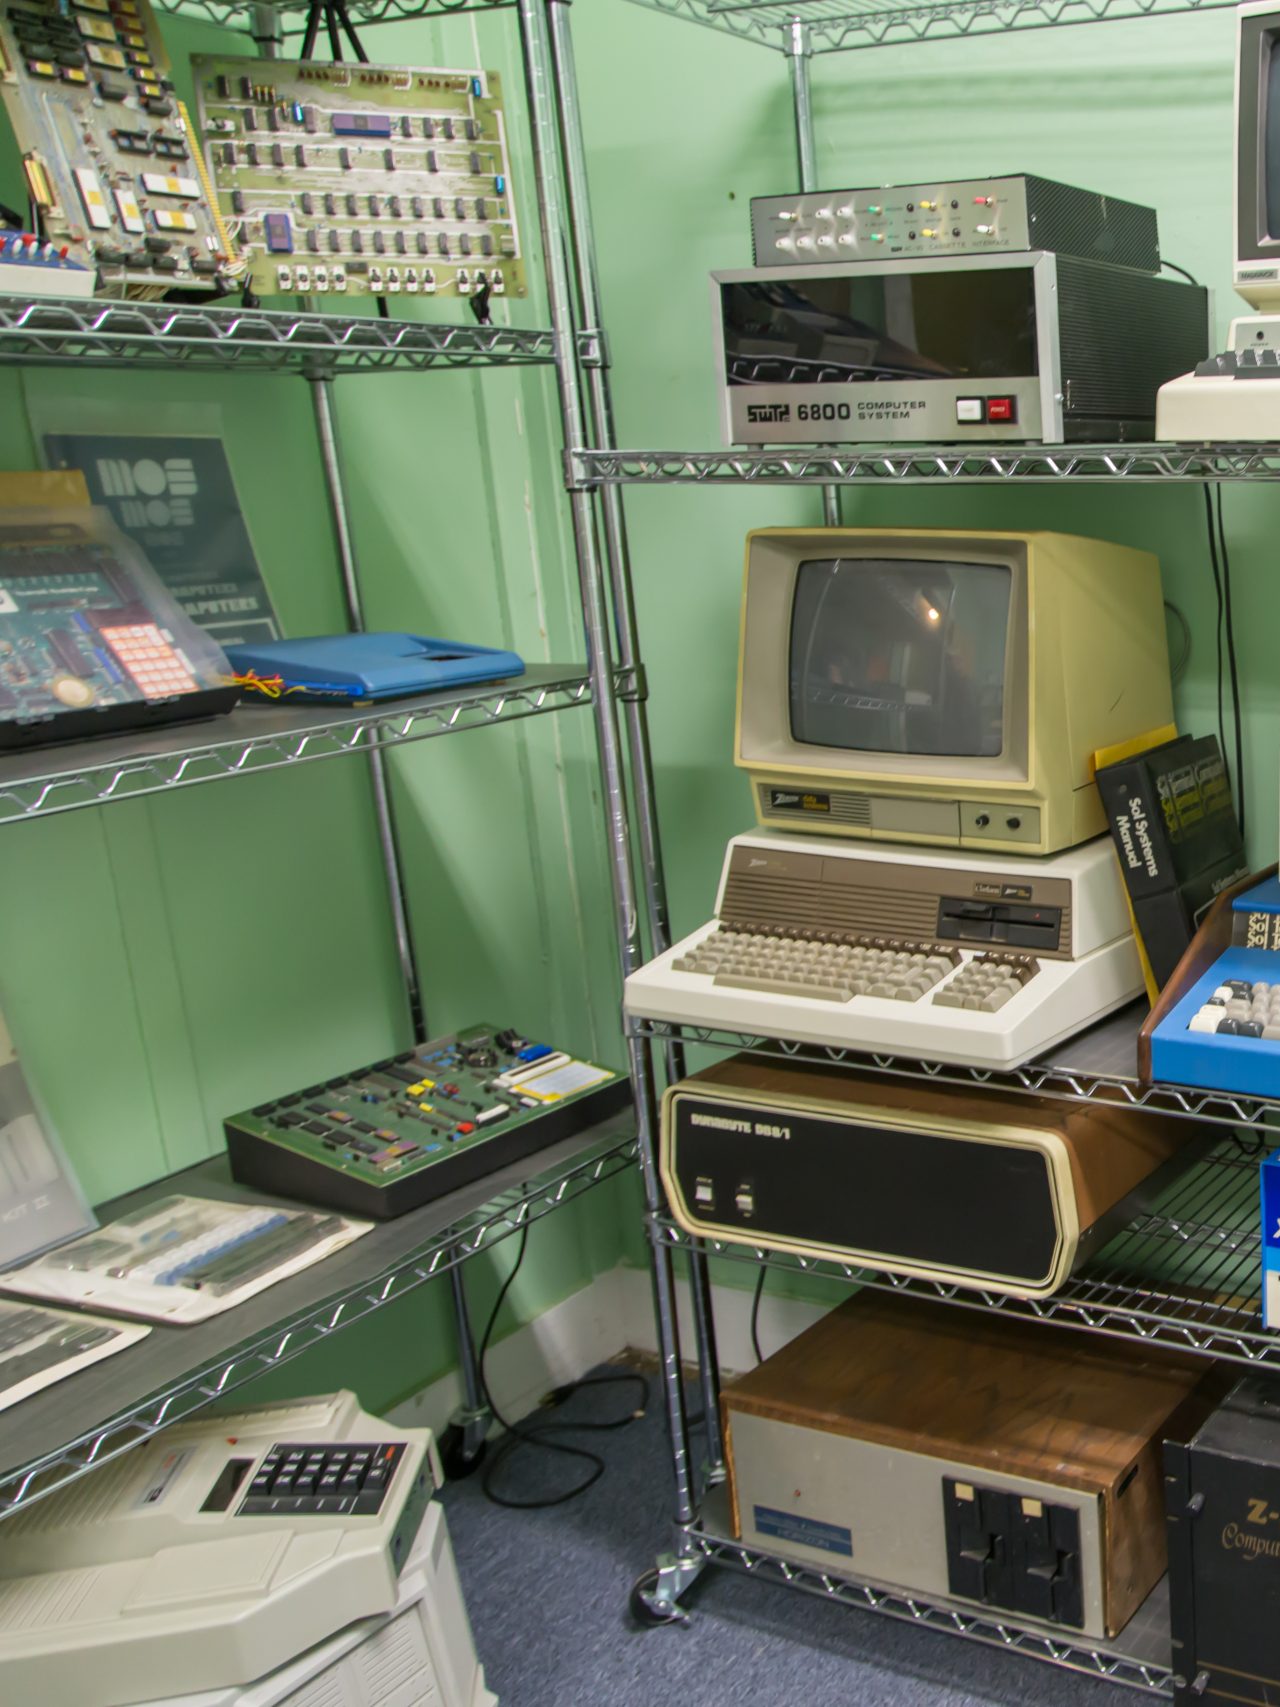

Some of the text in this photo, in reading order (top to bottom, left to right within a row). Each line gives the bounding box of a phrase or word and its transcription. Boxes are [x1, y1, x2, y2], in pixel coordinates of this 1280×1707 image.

[797, 403, 851, 421] 6800
[857, 400, 927, 410] COMPUTER
[857, 411, 910, 420] SYSTEM
[1116, 815, 1142, 869] Manual
[1129, 797, 1158, 877] Sol Systems
